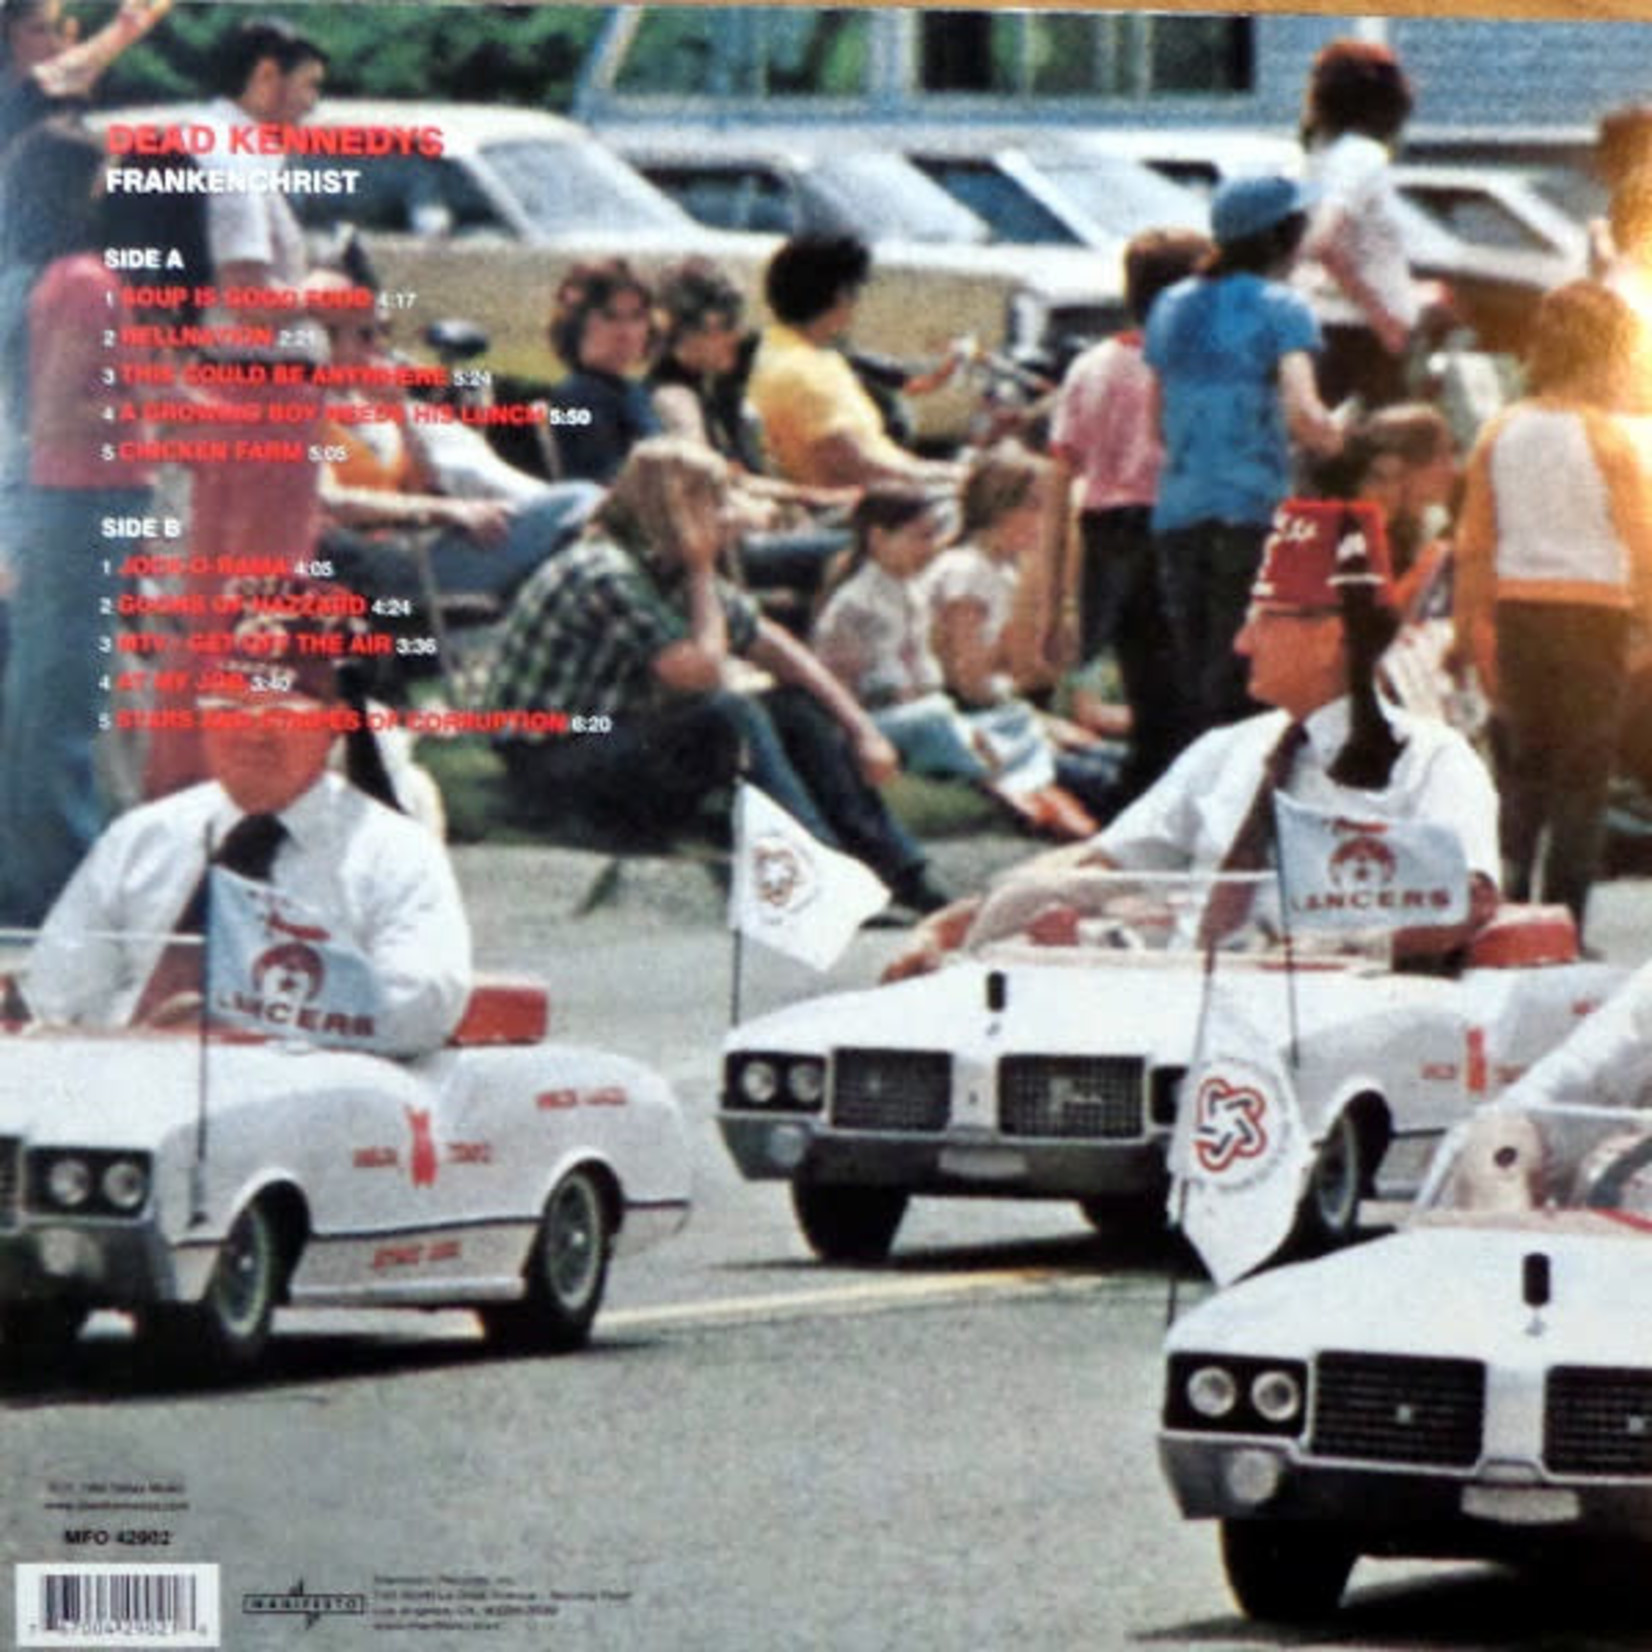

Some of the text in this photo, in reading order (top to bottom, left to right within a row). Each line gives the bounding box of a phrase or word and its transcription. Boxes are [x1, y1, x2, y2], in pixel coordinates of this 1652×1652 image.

[107, 125, 445, 158] DEAD KENNEDYS
[106, 169, 360, 194] FRANKENCHRIST
[104, 249, 184, 269] SIDE A
[106, 291, 113, 307] 1
[121, 286, 186, 309] SOUP
[194, 287, 216, 308] IS
[225, 287, 296, 309] GOOD
[304, 287, 372, 309] FOOD
[104, 329, 115, 347] 2
[120, 326, 273, 348] HELLNATION
[103, 368, 115, 385] 3
[121, 365, 174, 386] THIS
[183, 364, 266, 386] COULD
[273, 365, 305, 386] BE
[312, 365, 448, 387] ANYWHERE
[102, 404, 115, 420] 4
[120, 403, 136, 423] A
[143, 403, 262, 424] GROWING
[269, 403, 316, 423] BOY
[324, 404, 403, 424] NEEDS
[414, 404, 455, 424] HIS
[460, 404, 546, 425] LUNCH
[102, 444, 114, 460] 5
[119, 440, 228, 463] CHICKEN
[235, 441, 301, 463] FARM
[102, 518, 182, 538] SIDE B
[103, 561, 111, 574] 1
[294, 560, 334, 577] 4:05
[101, 594, 413, 617] 2 GOONS OF HAZZARD 4:24
[100, 637, 111, 653] 3
[118, 632, 166, 655] MTV
[188, 633, 232, 654] GET
[241, 633, 290, 655] OFF
[295, 633, 346, 655] THE
[350, 633, 394, 655] AIR
[396, 637, 438, 655] 3:36
[99, 674, 111, 690] 4
[117, 671, 147, 692] AT
[154, 671, 189, 692] MY
[99, 714, 111, 730] 5
[117, 709, 195, 730] STARS
[262, 709, 360, 732] STRIPES
[367, 710, 399, 731] OF
[406, 709, 569, 733] CORRUPTION
[571, 716, 612, 733] 6:20
[64, 1530, 110, 1545] MFO
